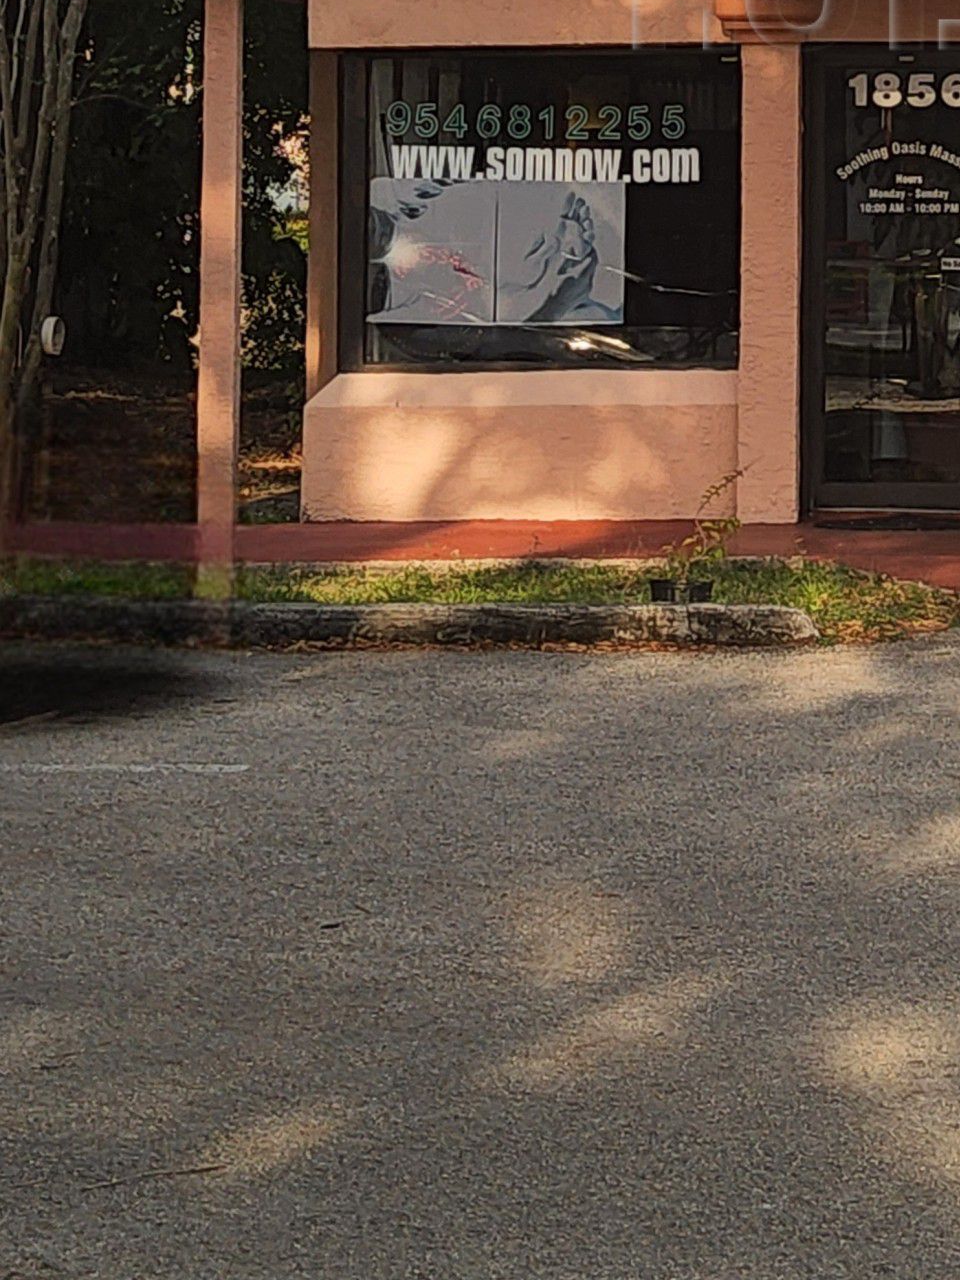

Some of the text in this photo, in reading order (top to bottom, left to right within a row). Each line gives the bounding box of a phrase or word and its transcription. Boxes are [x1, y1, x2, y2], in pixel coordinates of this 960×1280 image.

[386, 100, 687, 140] 9546812255
[391, 143, 701, 184] www.somnow.com
[836, 144, 889, 180] Soothing
[891, 141, 926, 156] Oasis
[896, 174, 924, 185] Hours
[868, 188, 906, 200] Monday
[914, 188, 949, 200] Sunday
[859, 203, 887, 214] 10:00
[888, 203, 905, 214] AM
[914, 203, 942, 214] 10:00
[943, 203, 960, 214] PM
